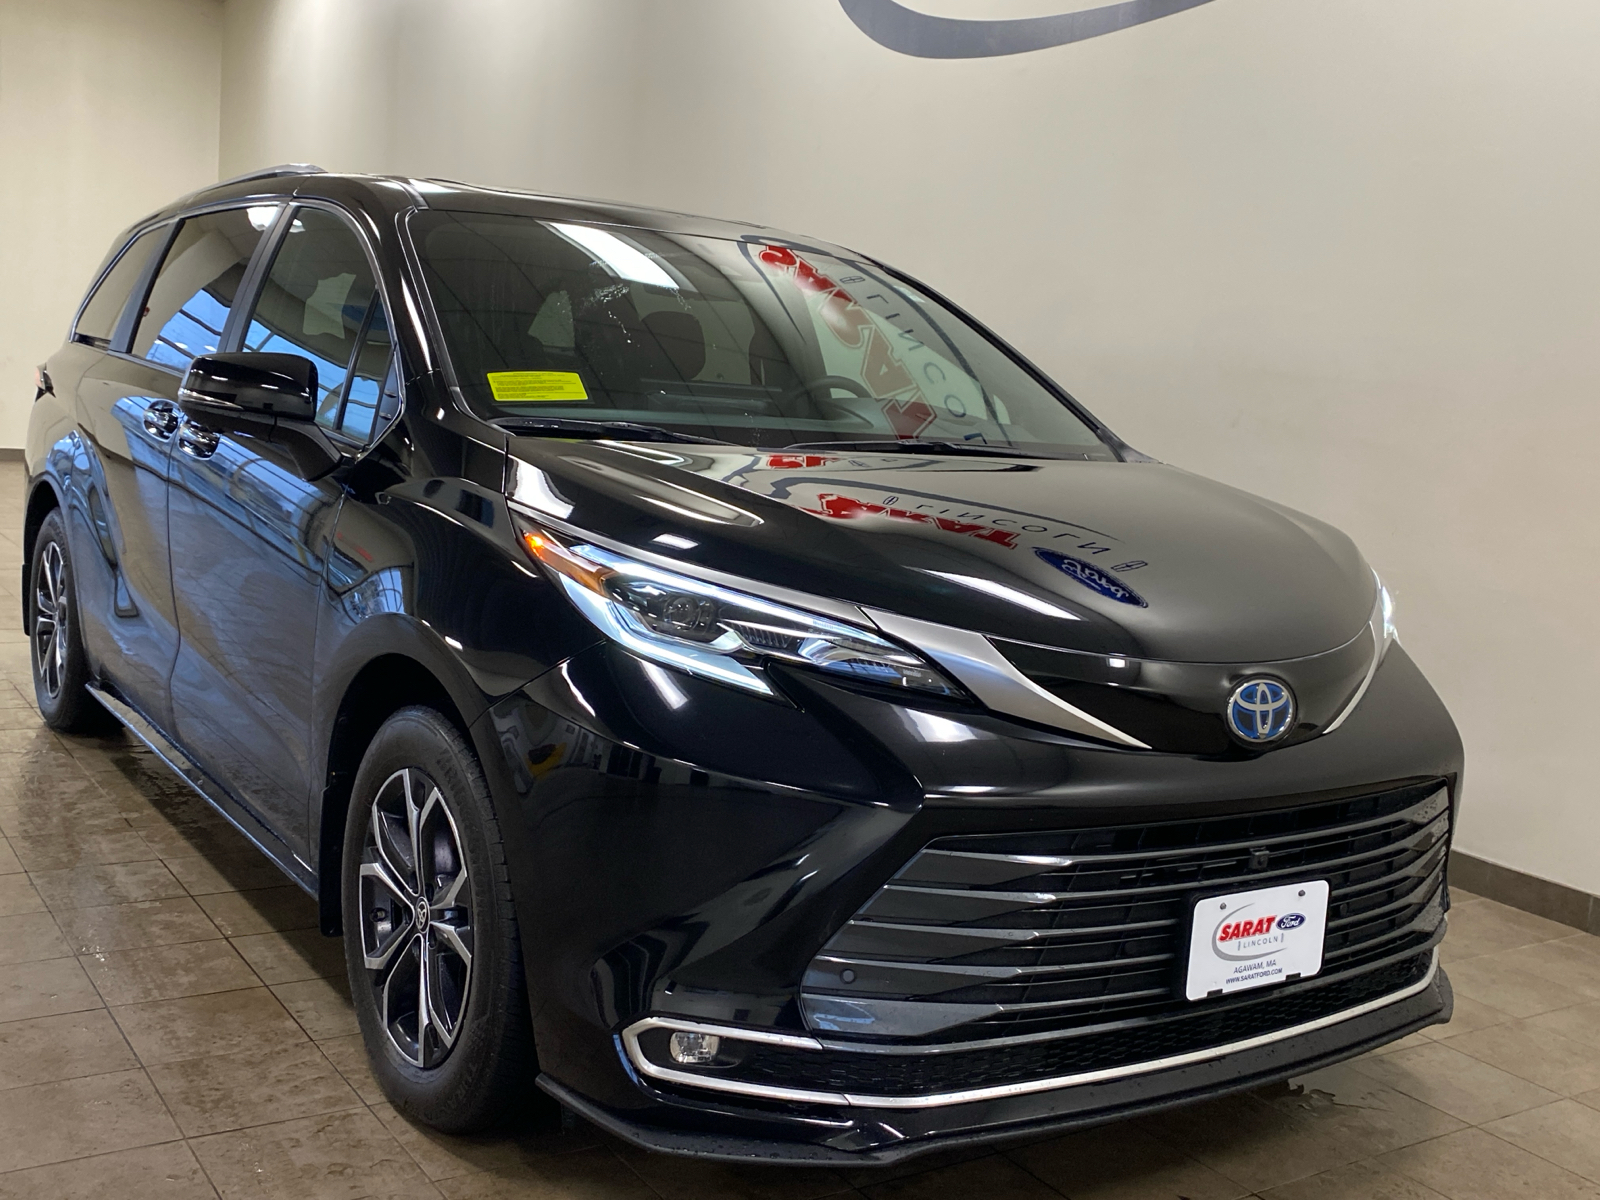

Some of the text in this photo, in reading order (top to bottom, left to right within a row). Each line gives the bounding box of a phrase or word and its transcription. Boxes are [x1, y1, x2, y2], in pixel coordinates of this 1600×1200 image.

[1217, 914, 1301, 943] SARAT Ford
[1243, 936, 1278, 949] LINCOLN
[1233, 959, 1277, 974] AGAWAM, MA
[1225, 967, 1283, 985] WWW.SARATFORD.COM
